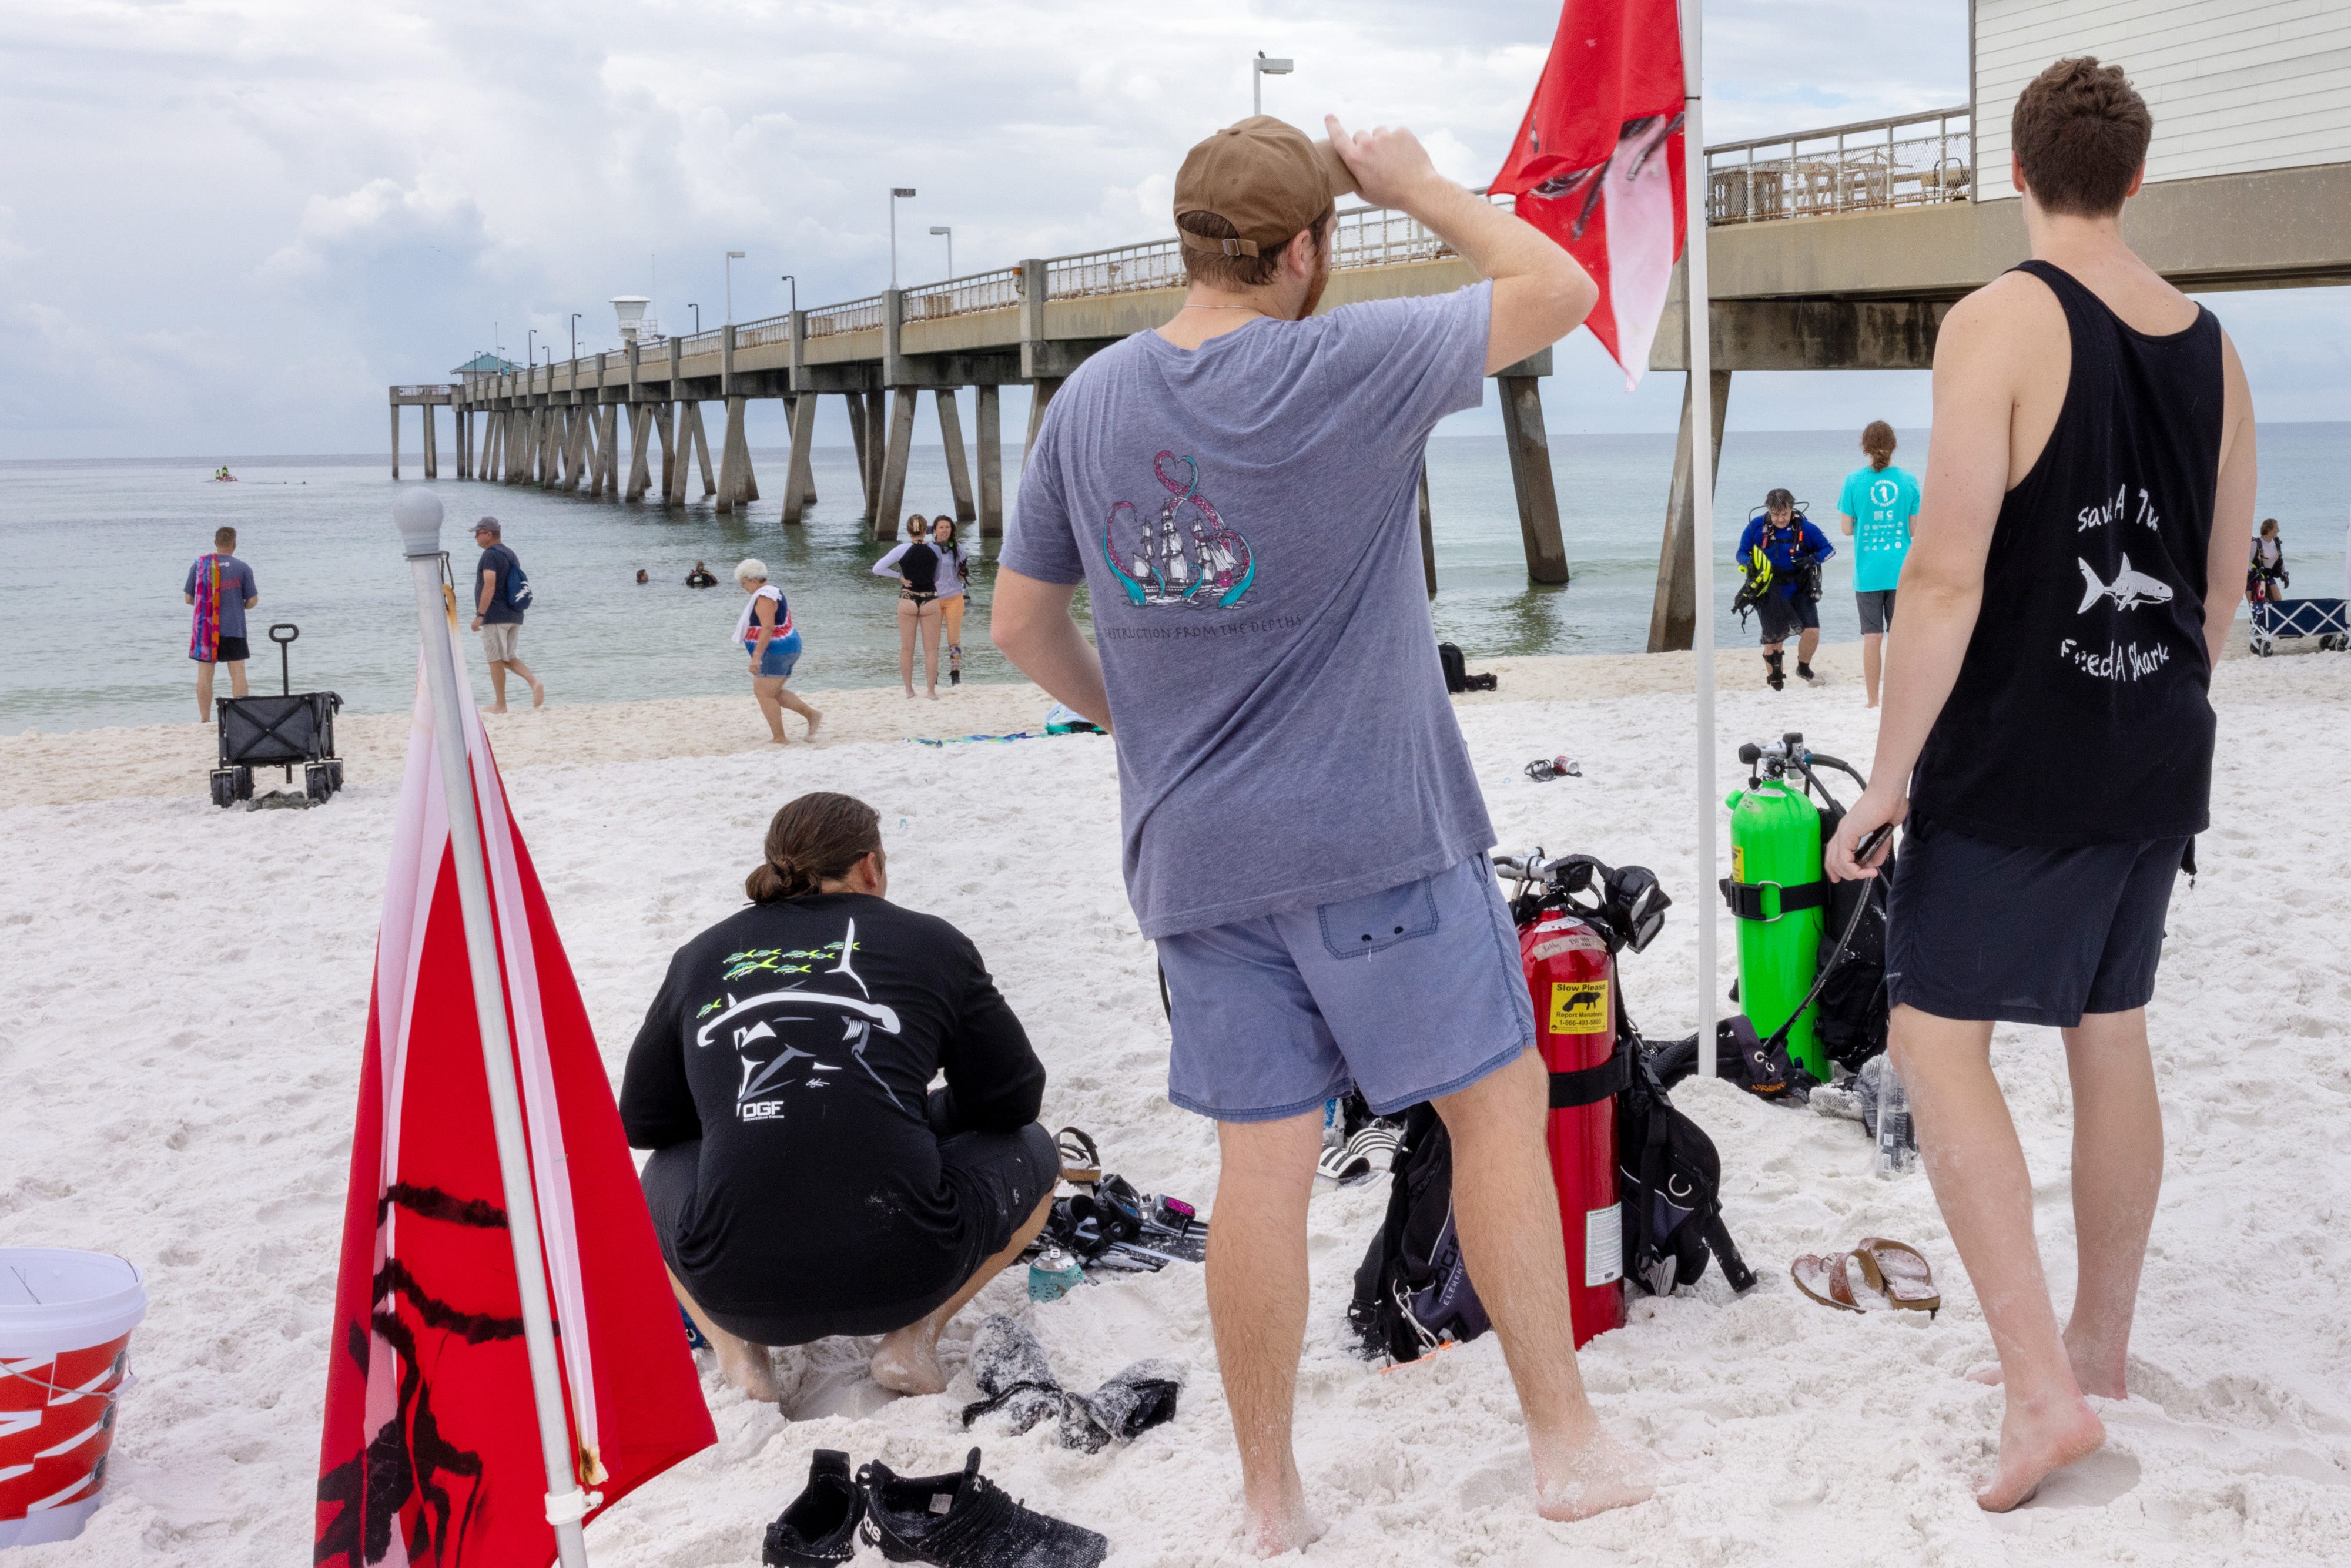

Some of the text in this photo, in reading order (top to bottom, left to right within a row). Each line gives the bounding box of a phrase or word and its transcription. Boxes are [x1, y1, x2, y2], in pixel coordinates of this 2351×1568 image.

[2077, 497, 2112, 532] sav
[2114, 483, 2125, 520] A
[1176, 625, 1216, 639] FROM
[1219, 622, 1247, 635] THE
[1251, 614, 1302, 633] DEPTHS
[2115, 645, 2126, 682] A
[2128, 641, 2170, 682] Shark
[743, 1101, 784, 1117] OGF
[1443, 1262, 1465, 1306] ELEMENT
